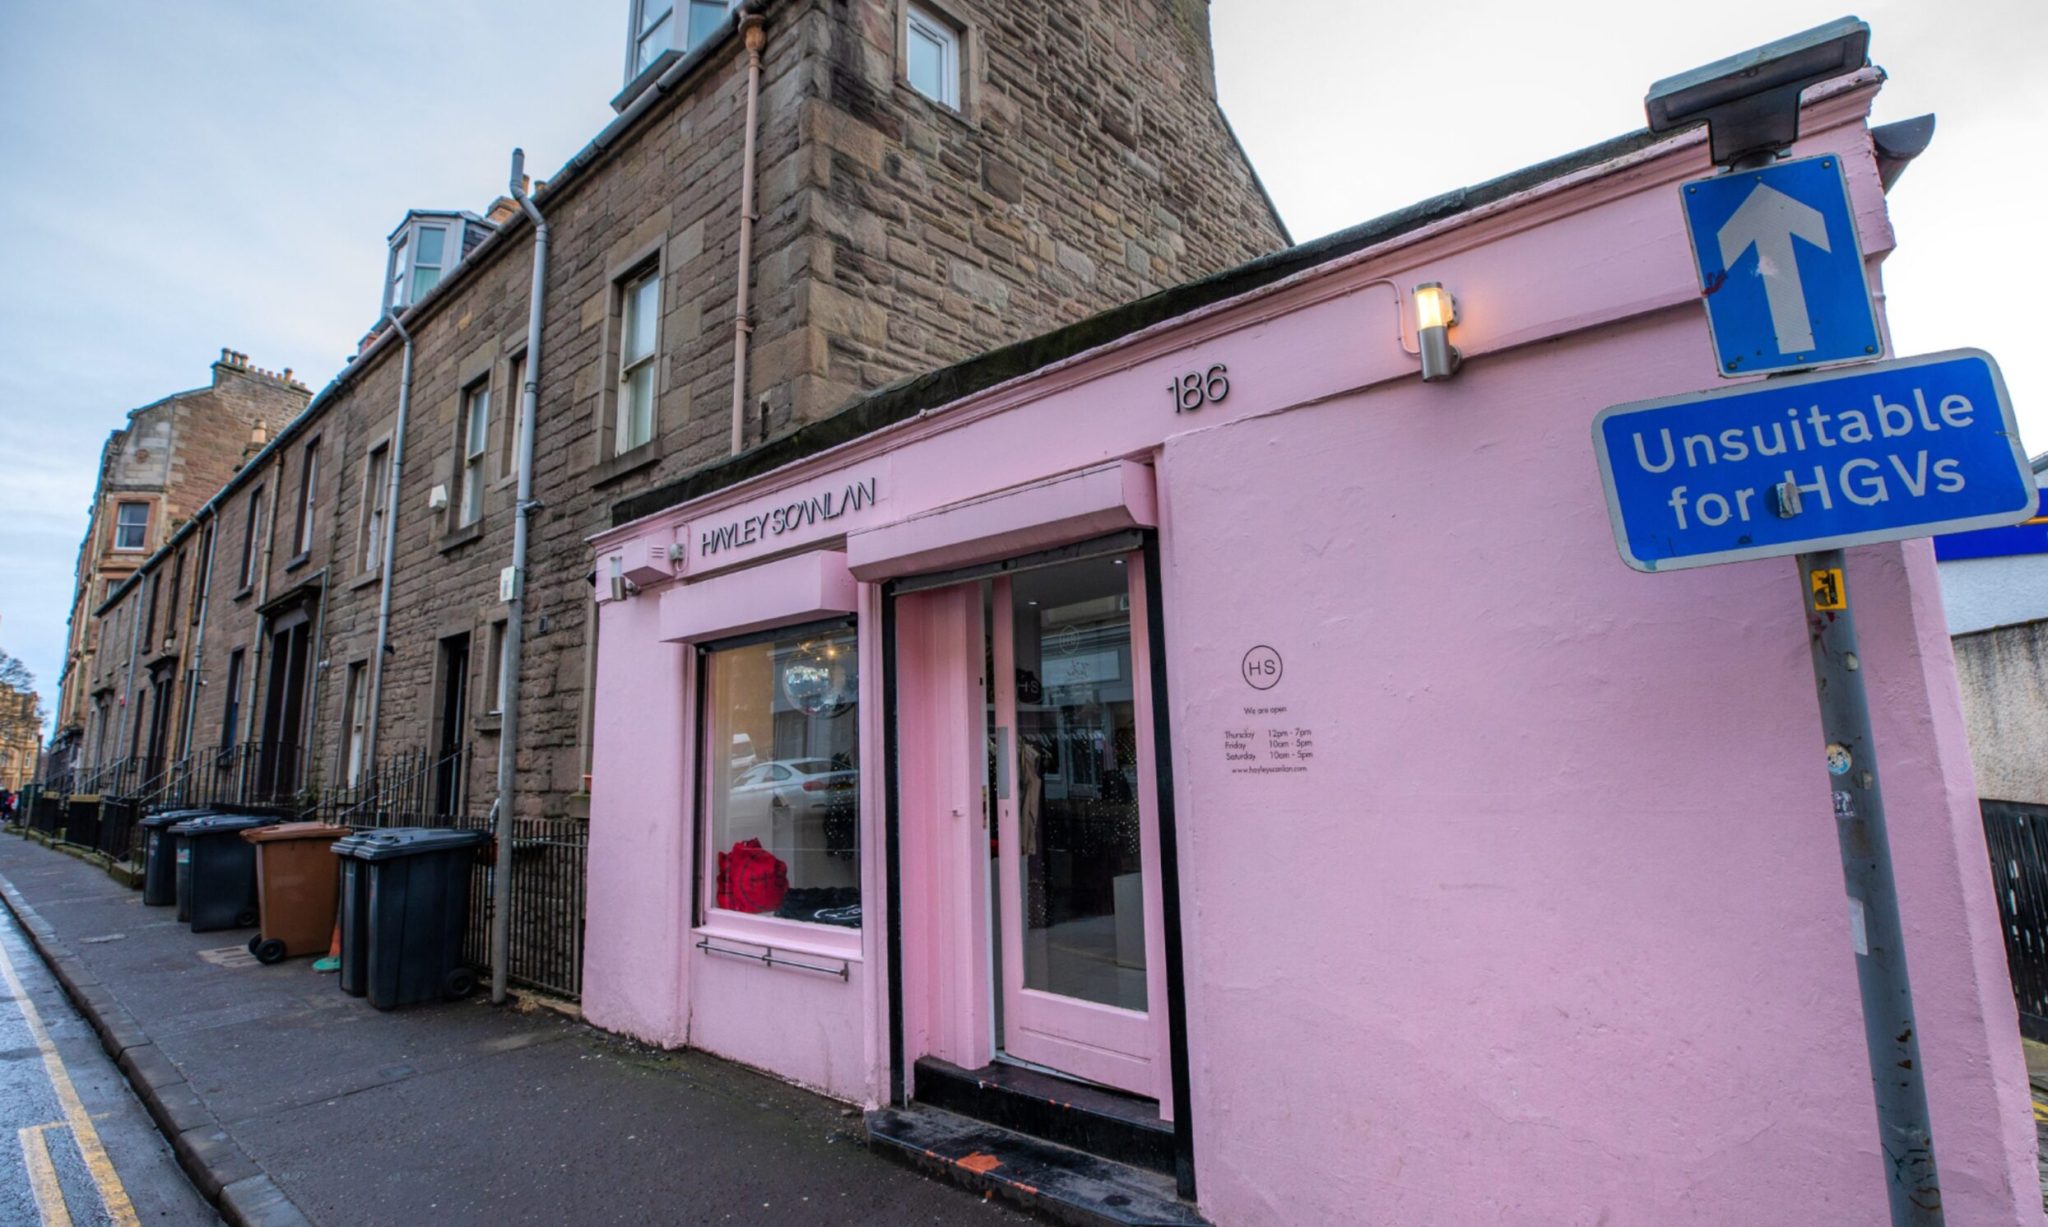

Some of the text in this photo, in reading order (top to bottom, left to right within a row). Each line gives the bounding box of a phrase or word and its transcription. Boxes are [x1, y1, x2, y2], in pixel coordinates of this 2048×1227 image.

[1166, 362, 1230, 414] 186
[1633, 387, 1974, 473] Unsuitable
[1668, 450, 1966, 530] for HGVs
[701, 516, 769, 557] HAYLEY
[1248, 659, 1276, 676] HS
[1225, 730, 1255, 740] Thursday
[1268, 729, 1289, 739] 12pm
[1295, 727, 1312, 737] 7pm
[1225, 741, 1246, 751] Friday
[1269, 740, 1289, 748] 10am
[1296, 739, 1313, 748] 5pm
[1226, 752, 1256, 761] Saturday
[1270, 751, 1290, 759] 10am
[1297, 750, 1314, 761] 5pm
